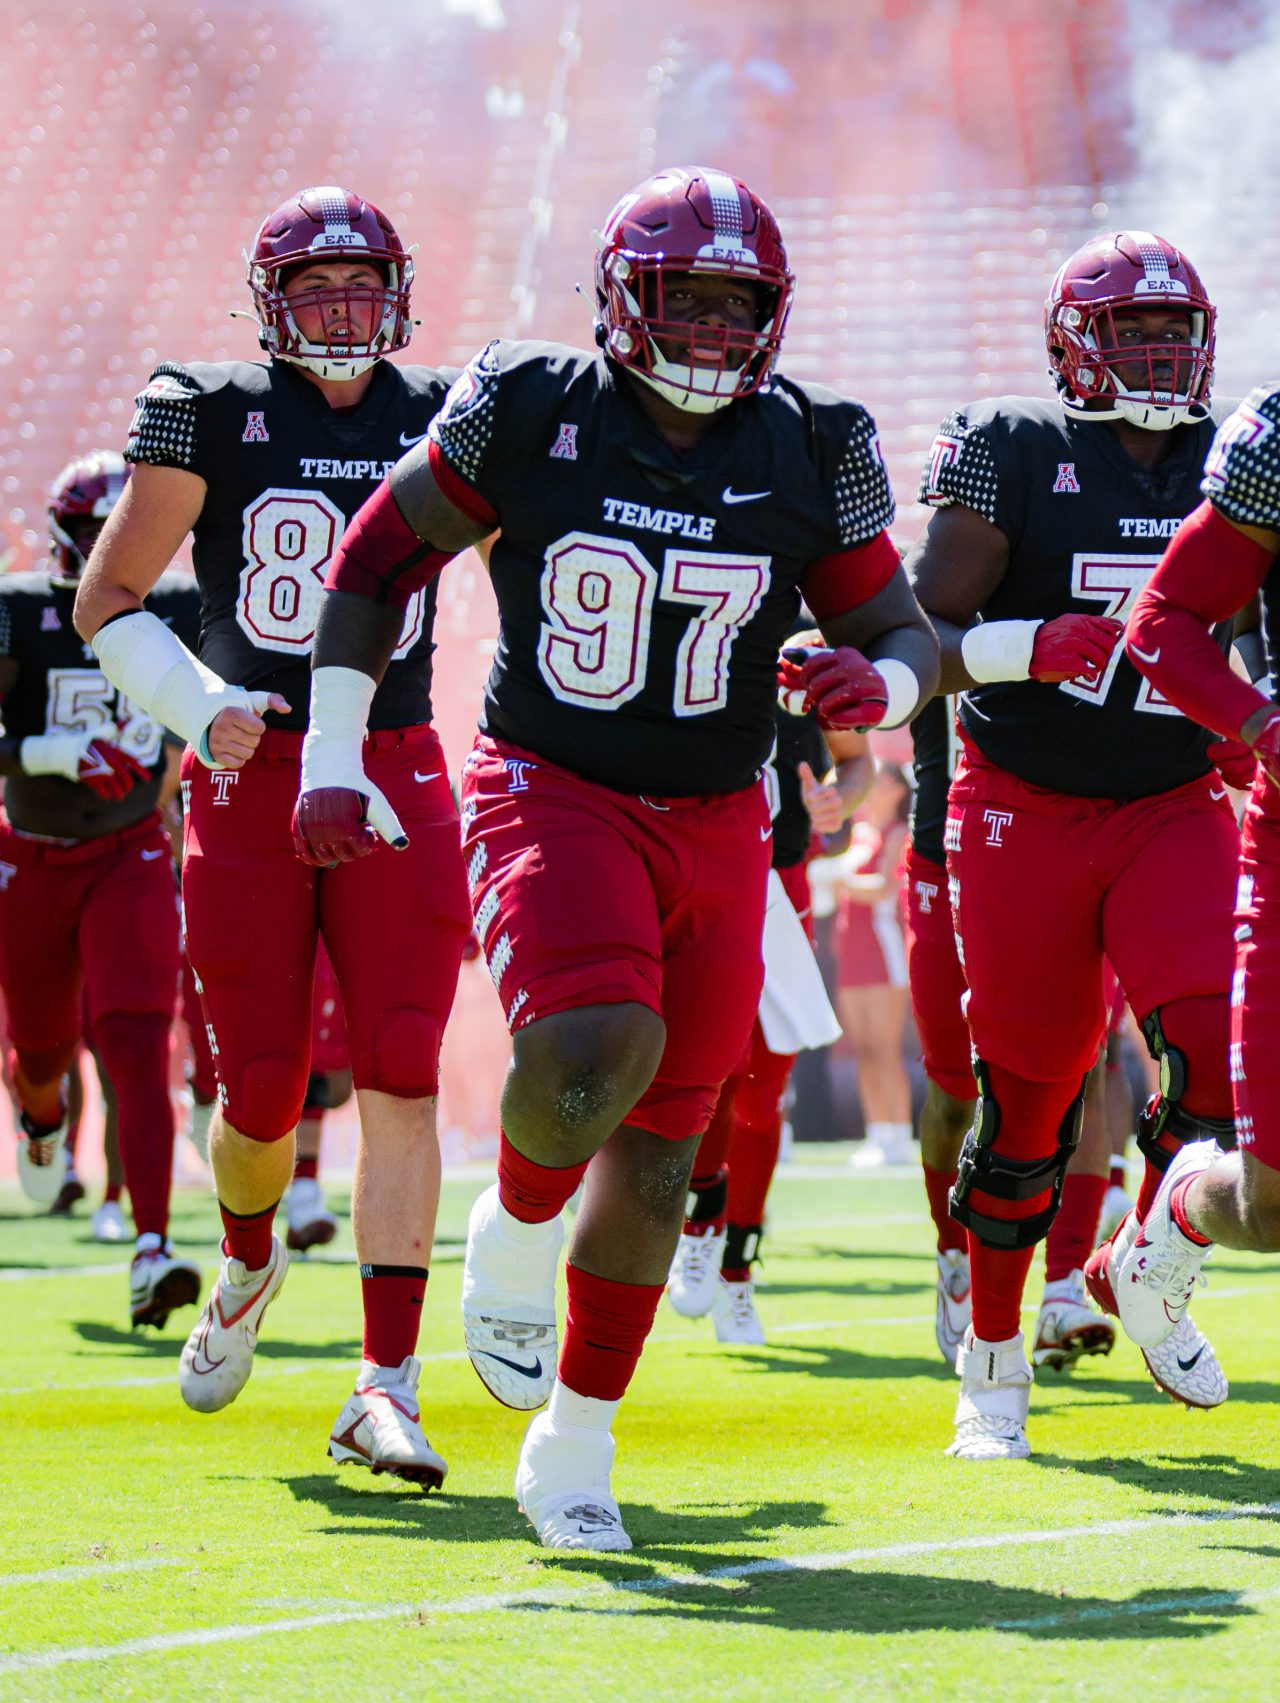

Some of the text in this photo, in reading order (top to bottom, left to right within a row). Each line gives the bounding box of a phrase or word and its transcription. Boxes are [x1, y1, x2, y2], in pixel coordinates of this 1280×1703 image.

[324, 234, 356, 245] EAT
[711, 247, 746, 262] EAT
[1147, 279, 1176, 291] EAT
[603, 497, 717, 541] TEMPLE
[1119, 518, 1184, 538] TEMP
[538, 530, 772, 718] 97
[210, 771, 239, 806] T
[983, 809, 1014, 847] T
